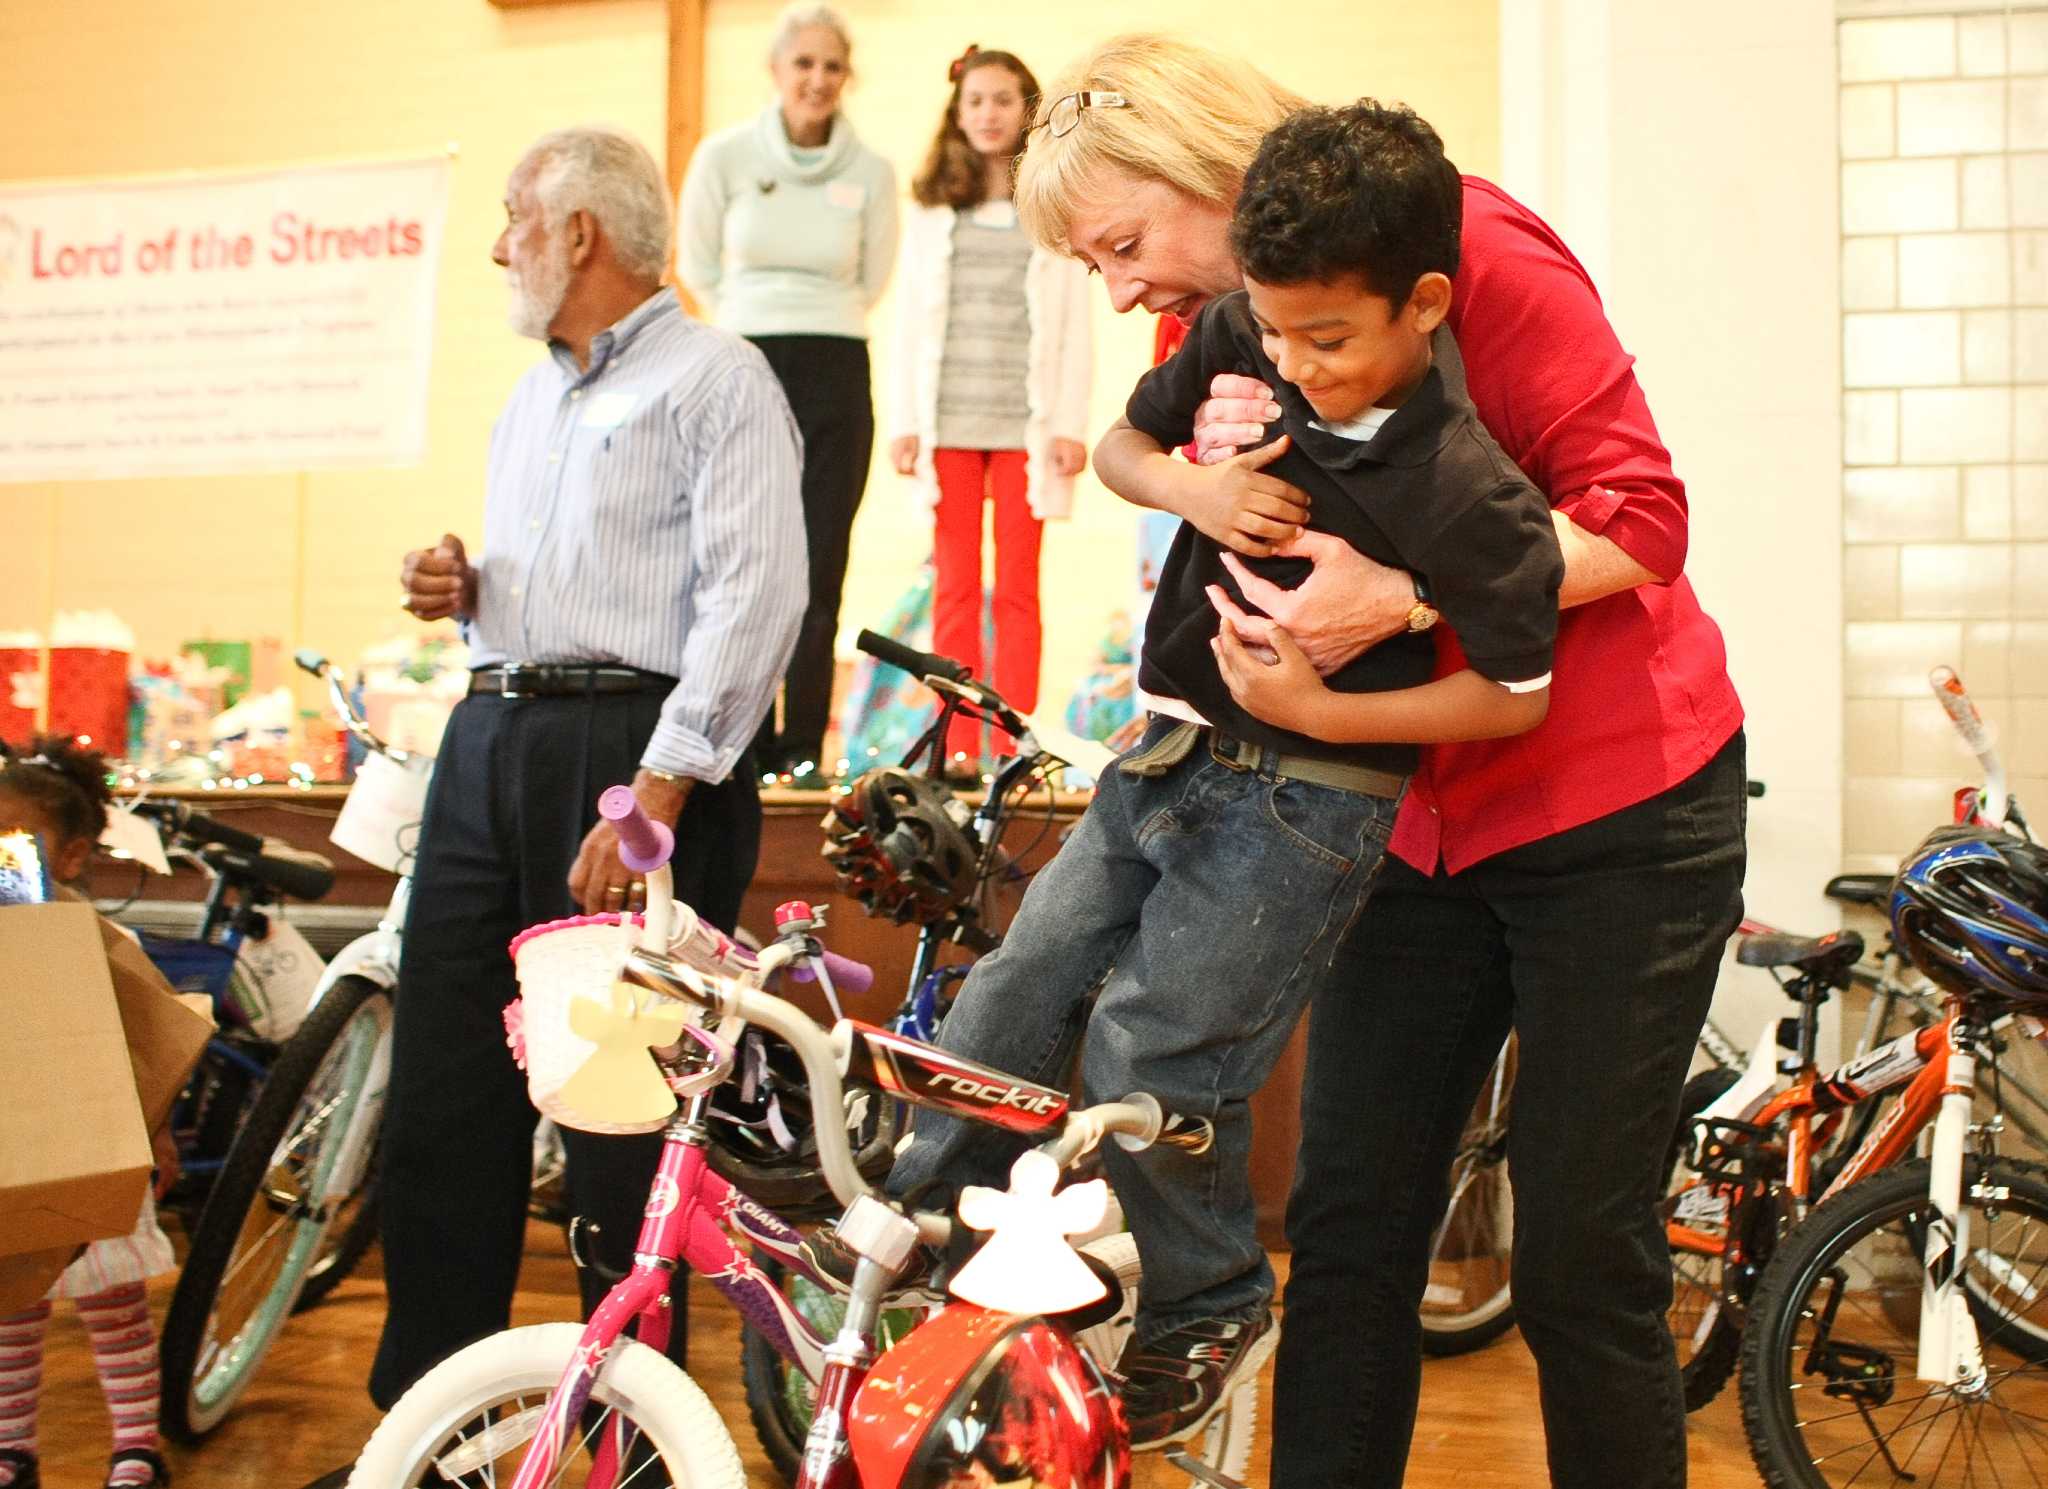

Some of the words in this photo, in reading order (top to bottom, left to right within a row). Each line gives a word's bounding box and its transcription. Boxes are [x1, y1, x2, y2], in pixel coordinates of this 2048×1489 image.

[32, 228, 124, 279] Lord
[136, 225, 178, 274] of
[190, 223, 254, 271] the
[270, 210, 425, 265] Streets
[927, 1071, 1061, 1115] rockit
